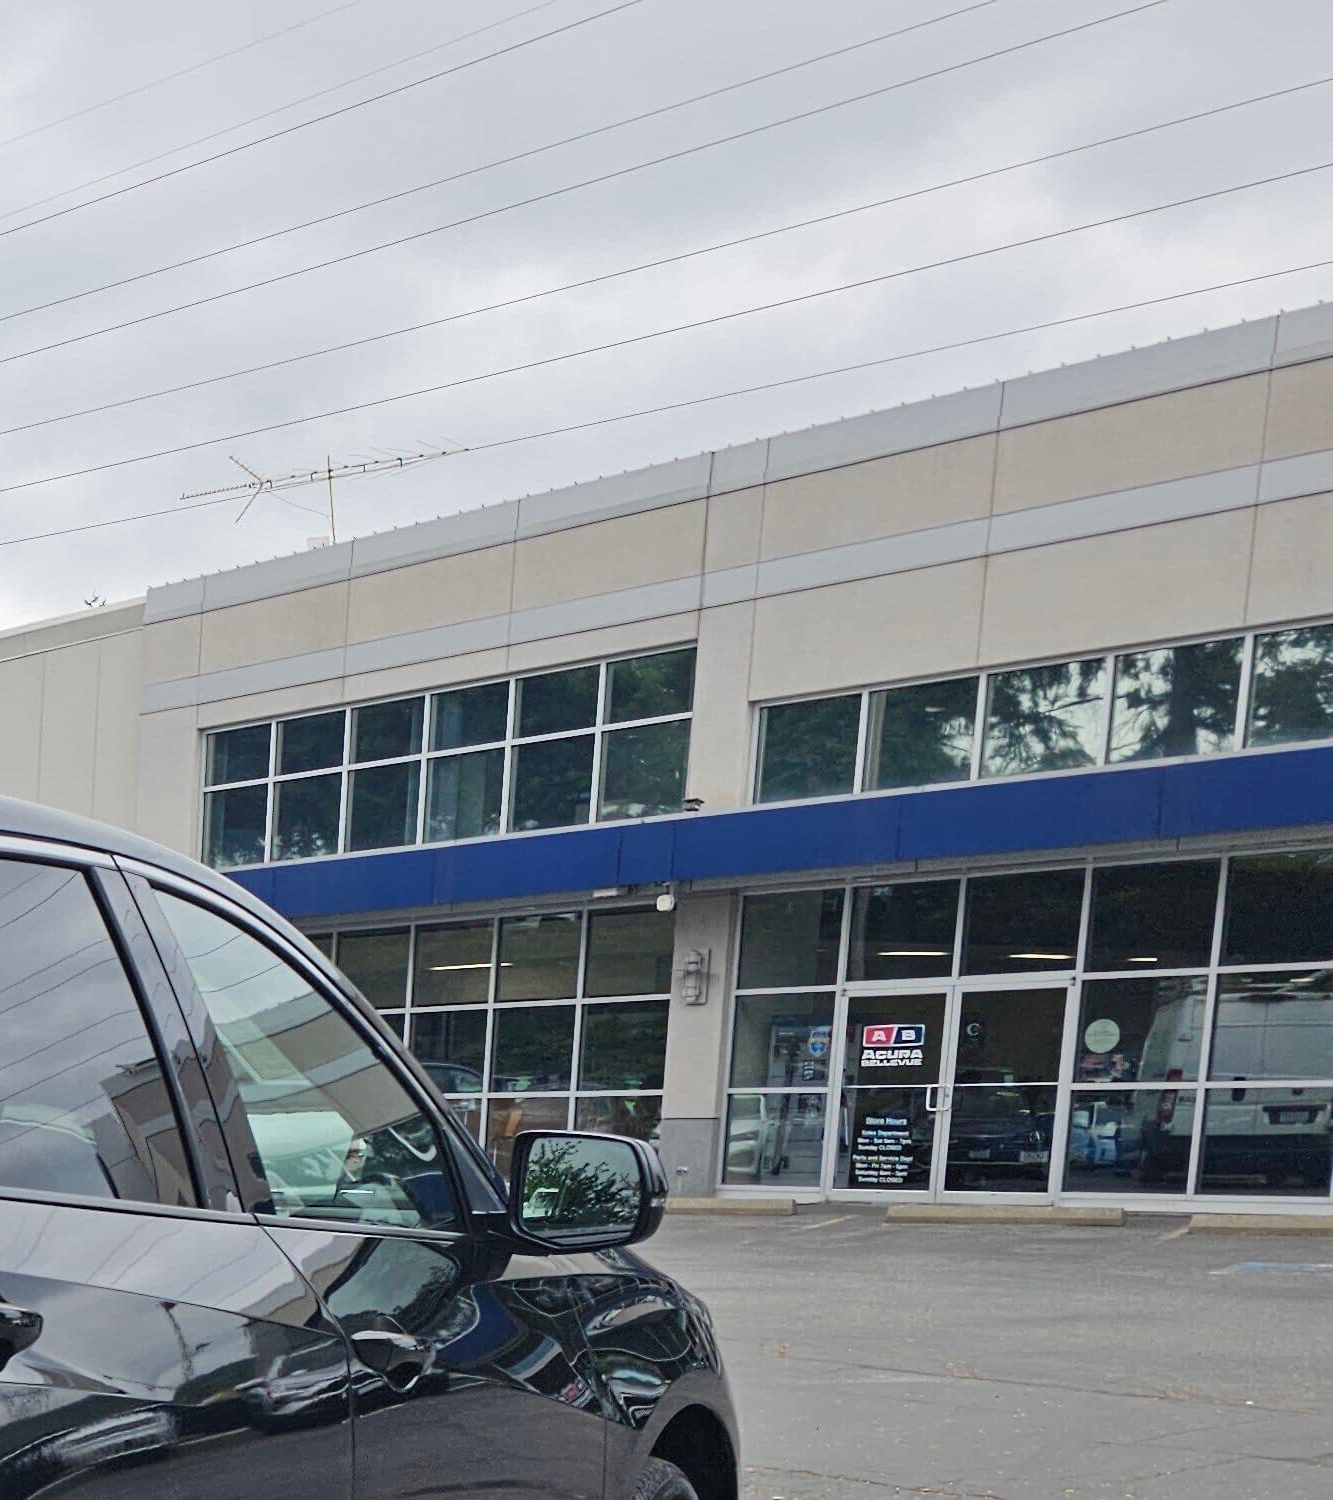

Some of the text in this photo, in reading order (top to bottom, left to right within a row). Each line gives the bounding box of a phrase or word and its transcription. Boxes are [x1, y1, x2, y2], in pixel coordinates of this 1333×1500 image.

[871, 1030, 916, 1041] A B
[862, 1049, 923, 1059] ACURA
[861, 1059, 923, 1067] BELLEVUE
[866, 1117, 907, 1126] Store Hours
